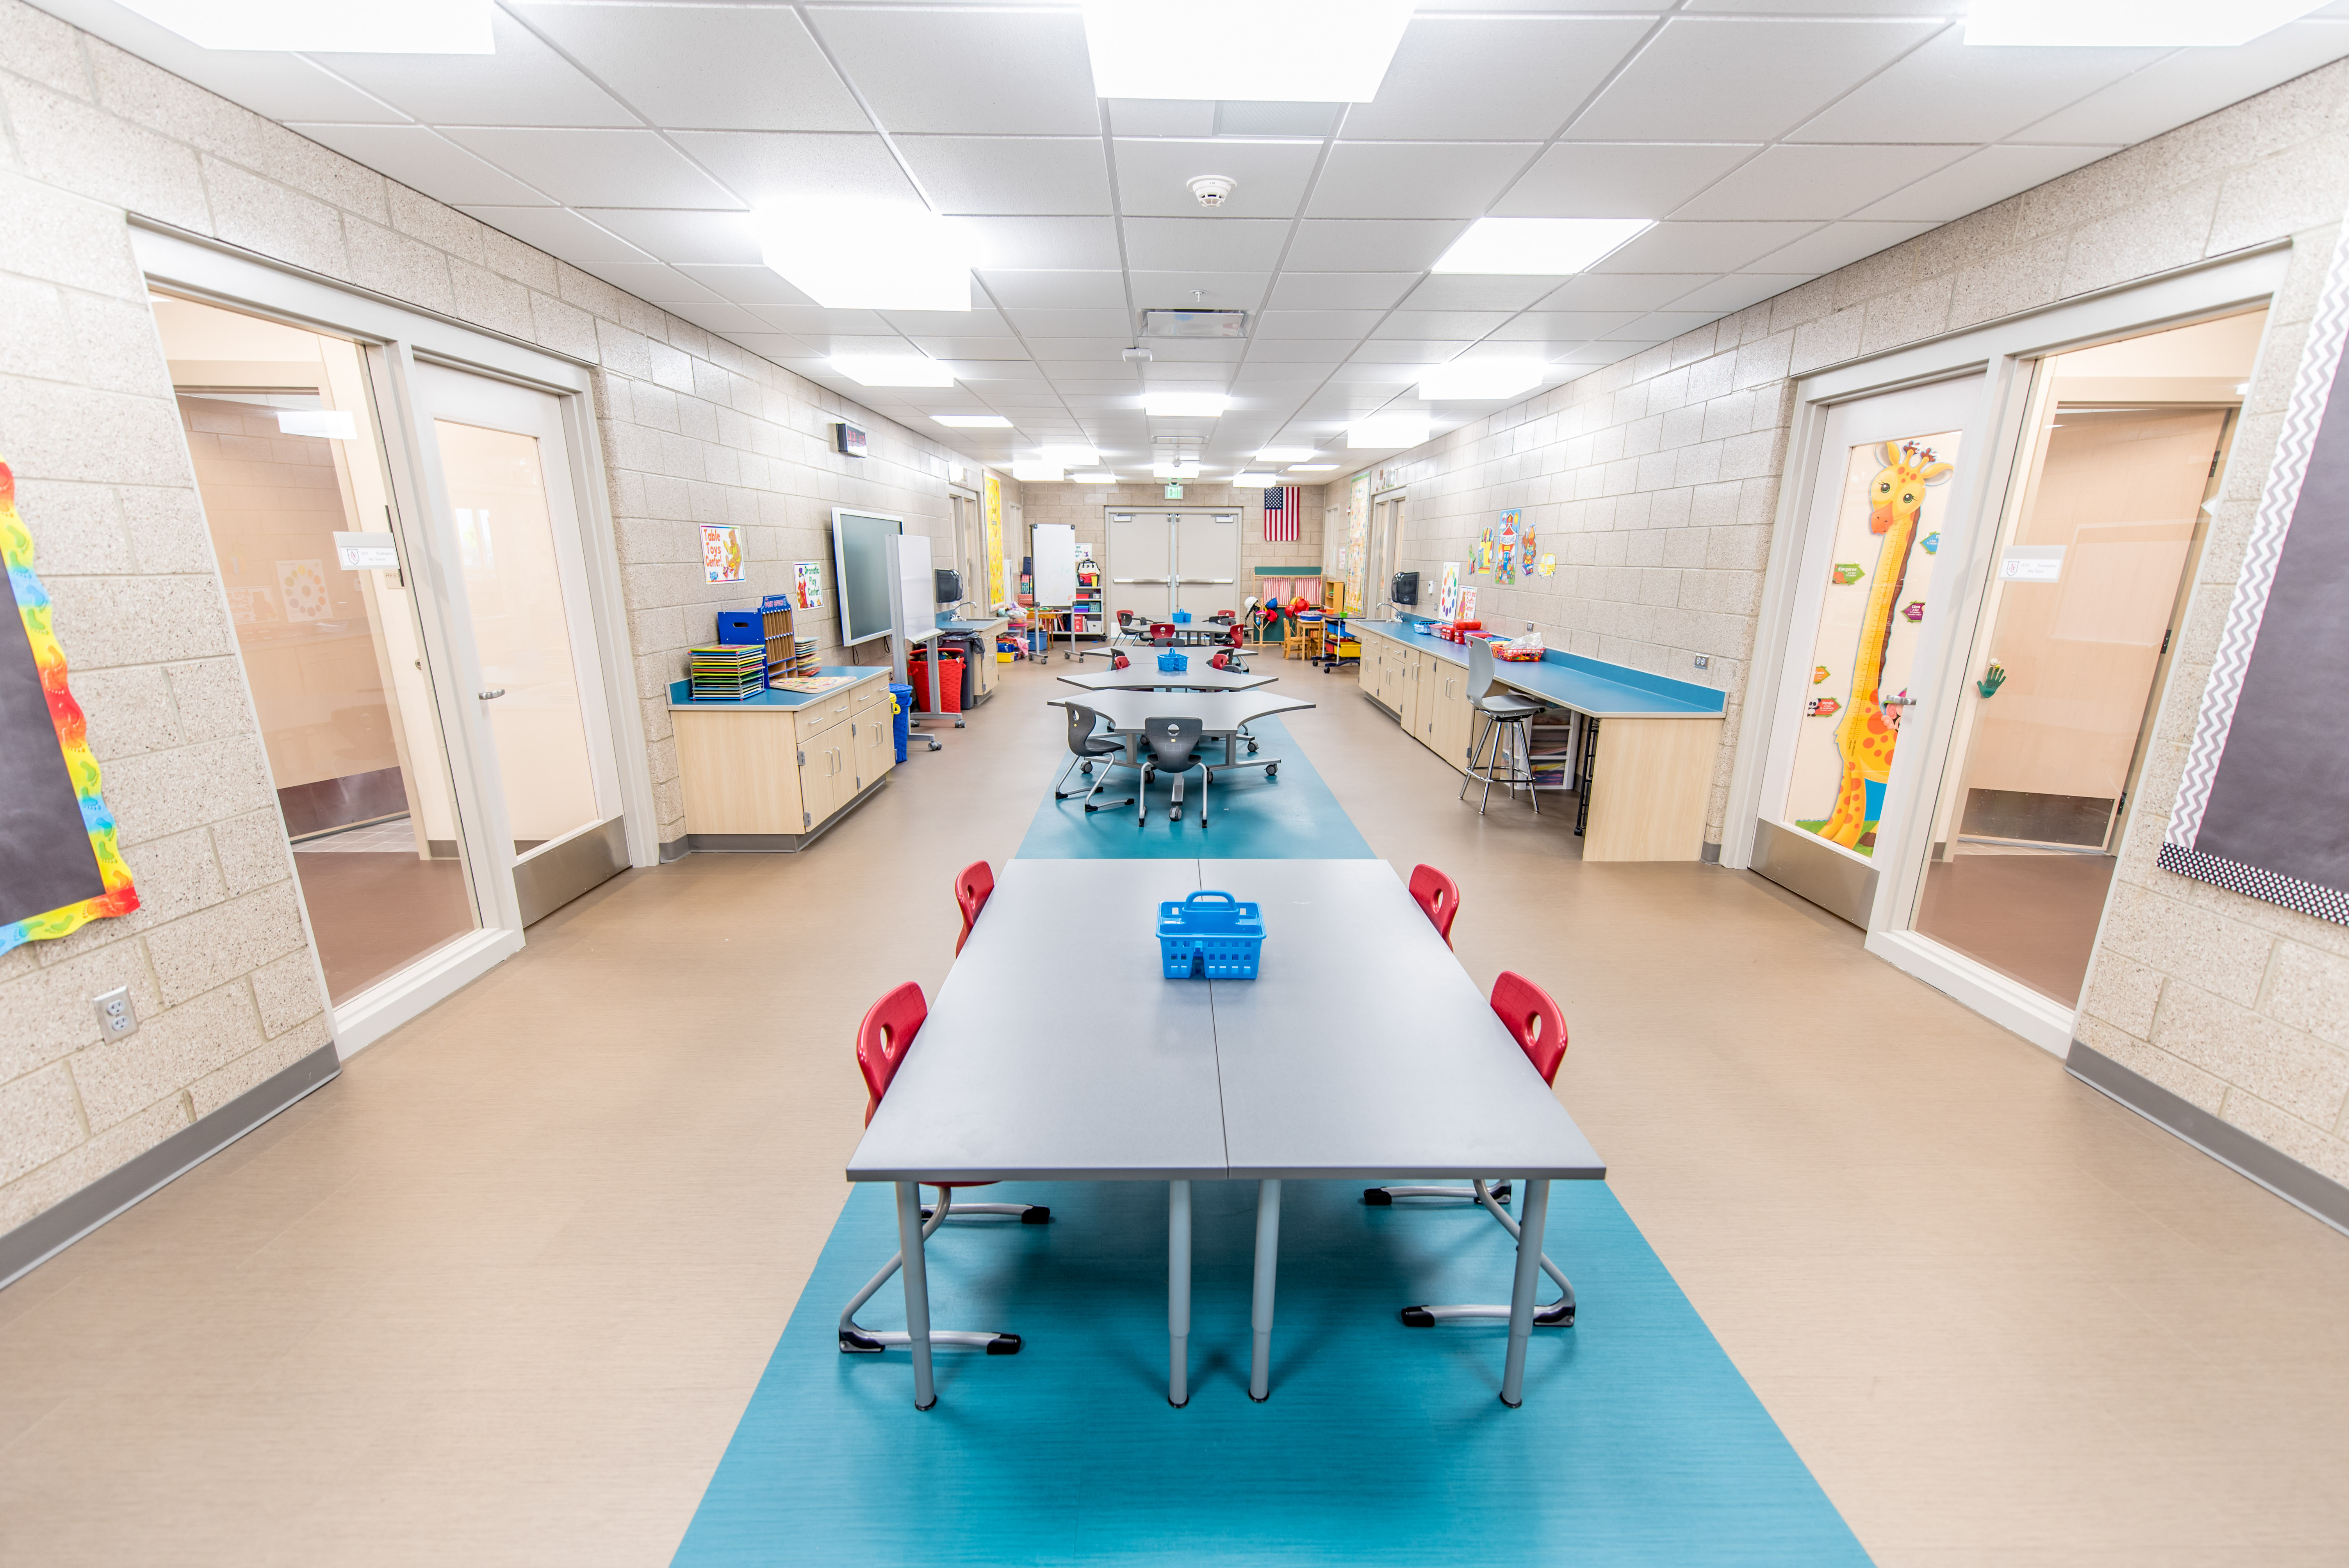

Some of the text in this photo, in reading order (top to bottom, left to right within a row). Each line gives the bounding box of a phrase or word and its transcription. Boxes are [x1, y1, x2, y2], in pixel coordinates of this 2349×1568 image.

[1167, 487, 1181, 498] EXIT
[704, 529, 720, 541] Table
[1501, 535, 1515, 544] WELCOME
[706, 542, 721, 557] Toys
[705, 555, 723, 567] Center!
[804, 565, 819, 575] Dramatic
[808, 586, 820, 596] Center!
[773, 599, 784, 607] OFFICE
[1465, 604, 1474, 612] Center!
